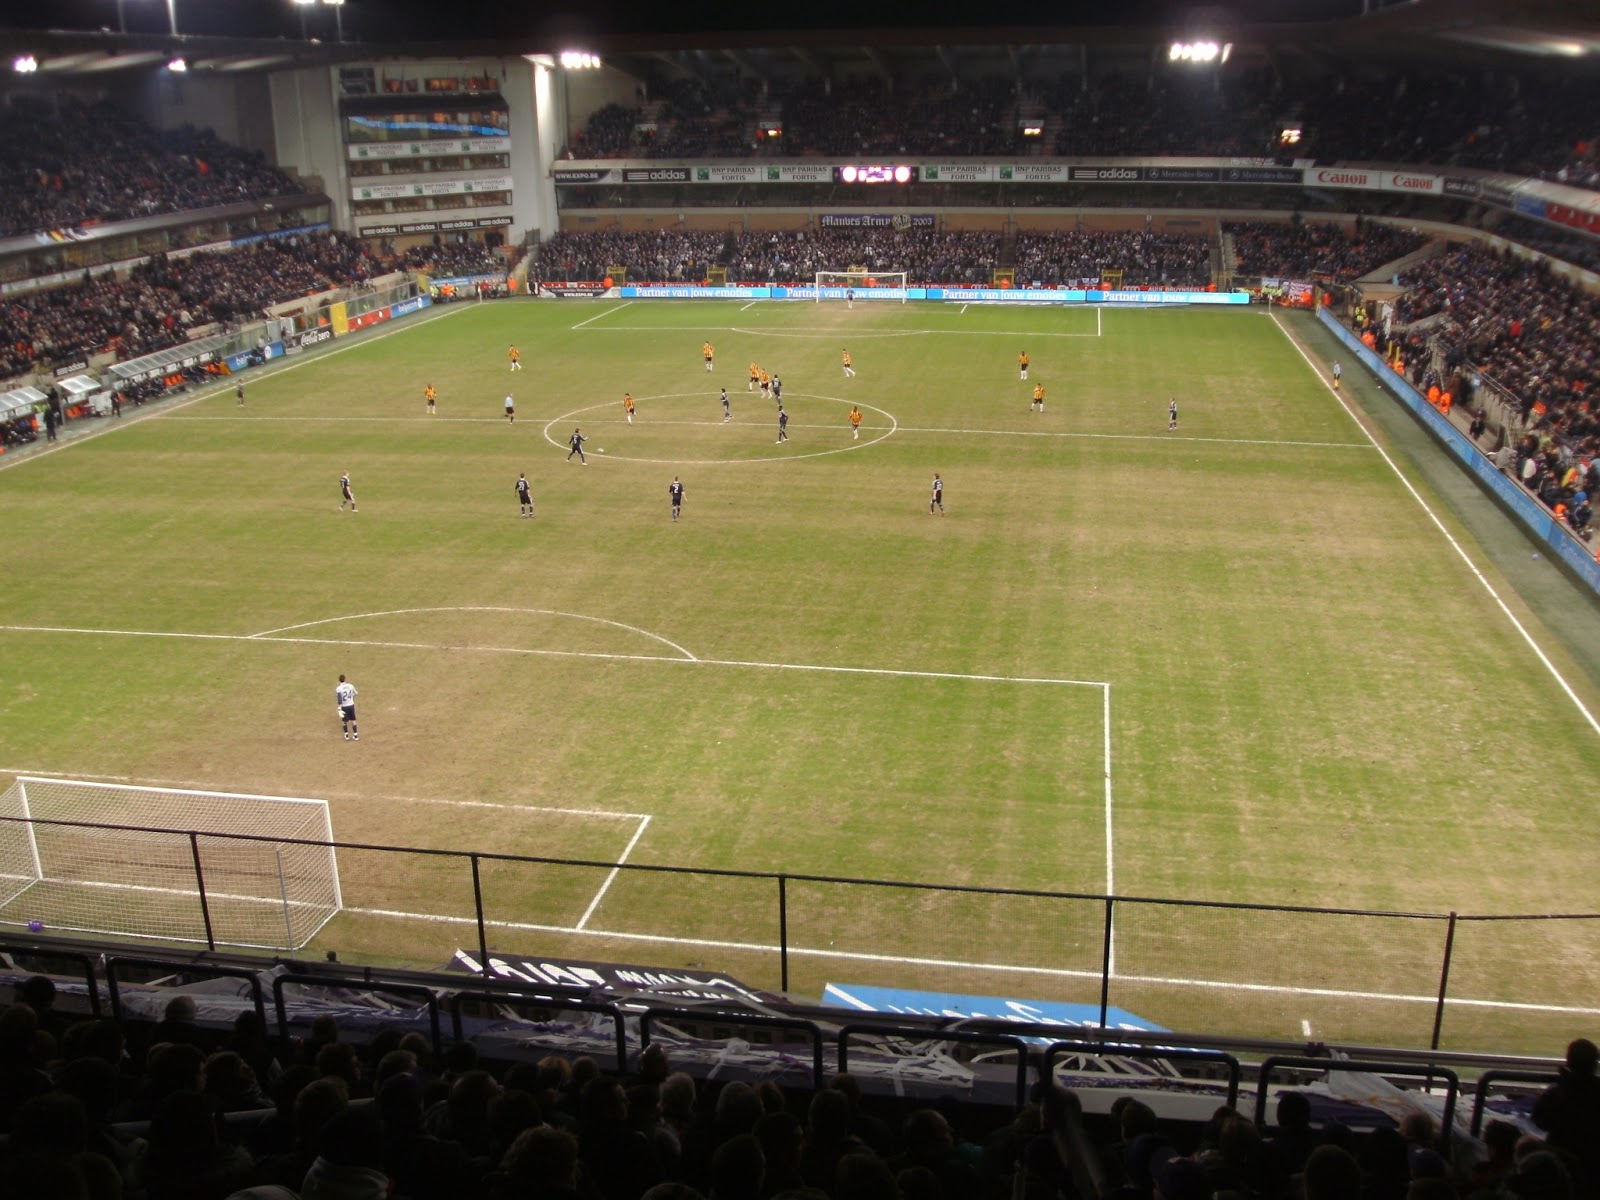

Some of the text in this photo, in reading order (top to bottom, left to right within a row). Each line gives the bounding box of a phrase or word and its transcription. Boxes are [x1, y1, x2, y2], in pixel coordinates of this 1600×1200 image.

[650, 170, 686, 180] adidas
[1099, 170, 1137, 178] adidas
[1318, 170, 1368, 184] Canon
[1392, 175, 1432, 189] Canon
[822, 216, 932, 226] Mauves Army 2003
[636, 288, 670, 296] Partner
[690, 288, 714, 298] jouw
[716, 288, 752, 297] emoties
[942, 290, 977, 299] Partner
[1001, 290, 1024, 300] jouw
[1103, 292, 1138, 301] Partner
[1142, 293, 1159, 301] van
[318, 330, 330, 340] zero
[342, 690, 352, 701] 24
